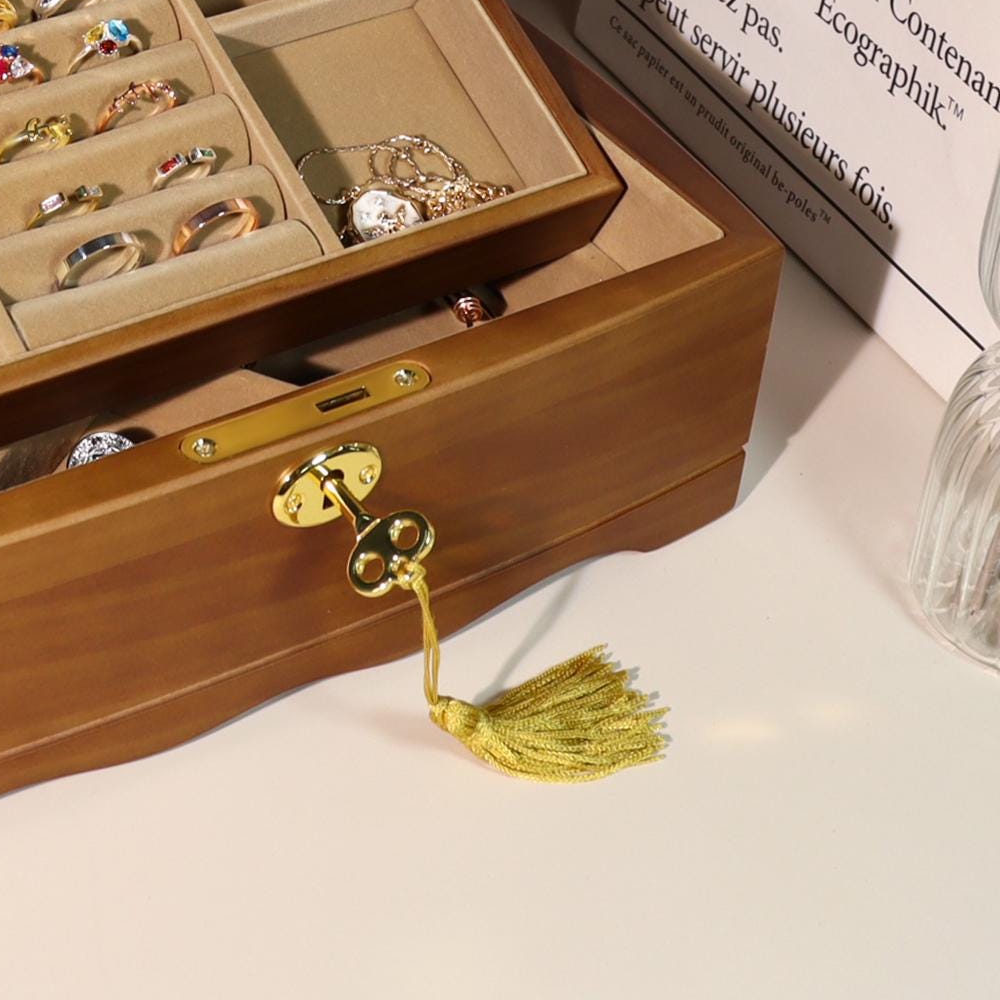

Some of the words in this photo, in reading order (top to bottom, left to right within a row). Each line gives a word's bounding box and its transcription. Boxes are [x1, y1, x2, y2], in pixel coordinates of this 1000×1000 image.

[609, 16, 623, 34] Ce
[622, 31, 638, 49] sac
[636, 46, 669, 78] papier
[669, 76, 684, 93] est
[730, 136, 772, 178] original
[741, 3, 782, 53] pas.
[690, 24, 750, 88] servir
[746, 79, 849, 182] plusieurs
[848, 167, 895, 231] fois.
